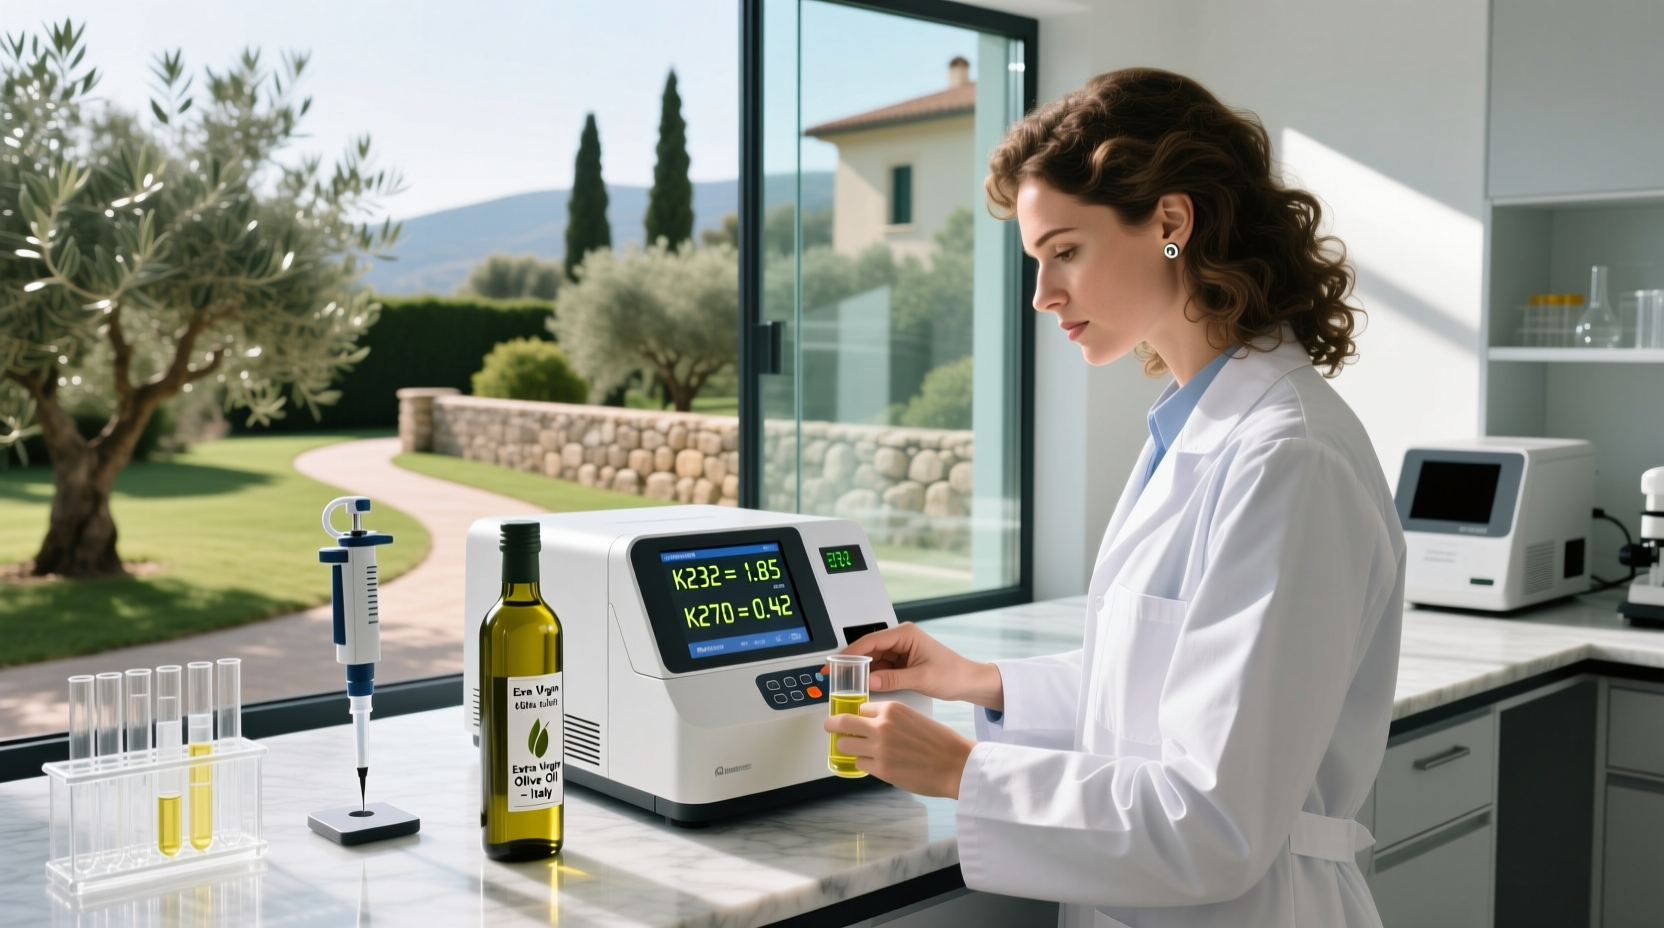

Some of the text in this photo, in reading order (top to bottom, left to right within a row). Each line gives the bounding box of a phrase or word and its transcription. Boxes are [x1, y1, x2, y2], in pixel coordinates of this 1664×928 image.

[672, 565, 722, 590] K232
[744, 558, 780, 582] 1.85
[684, 602, 735, 628] K270
[752, 594, 793, 620] 0.42
[530, 787, 552, 800] Italy
